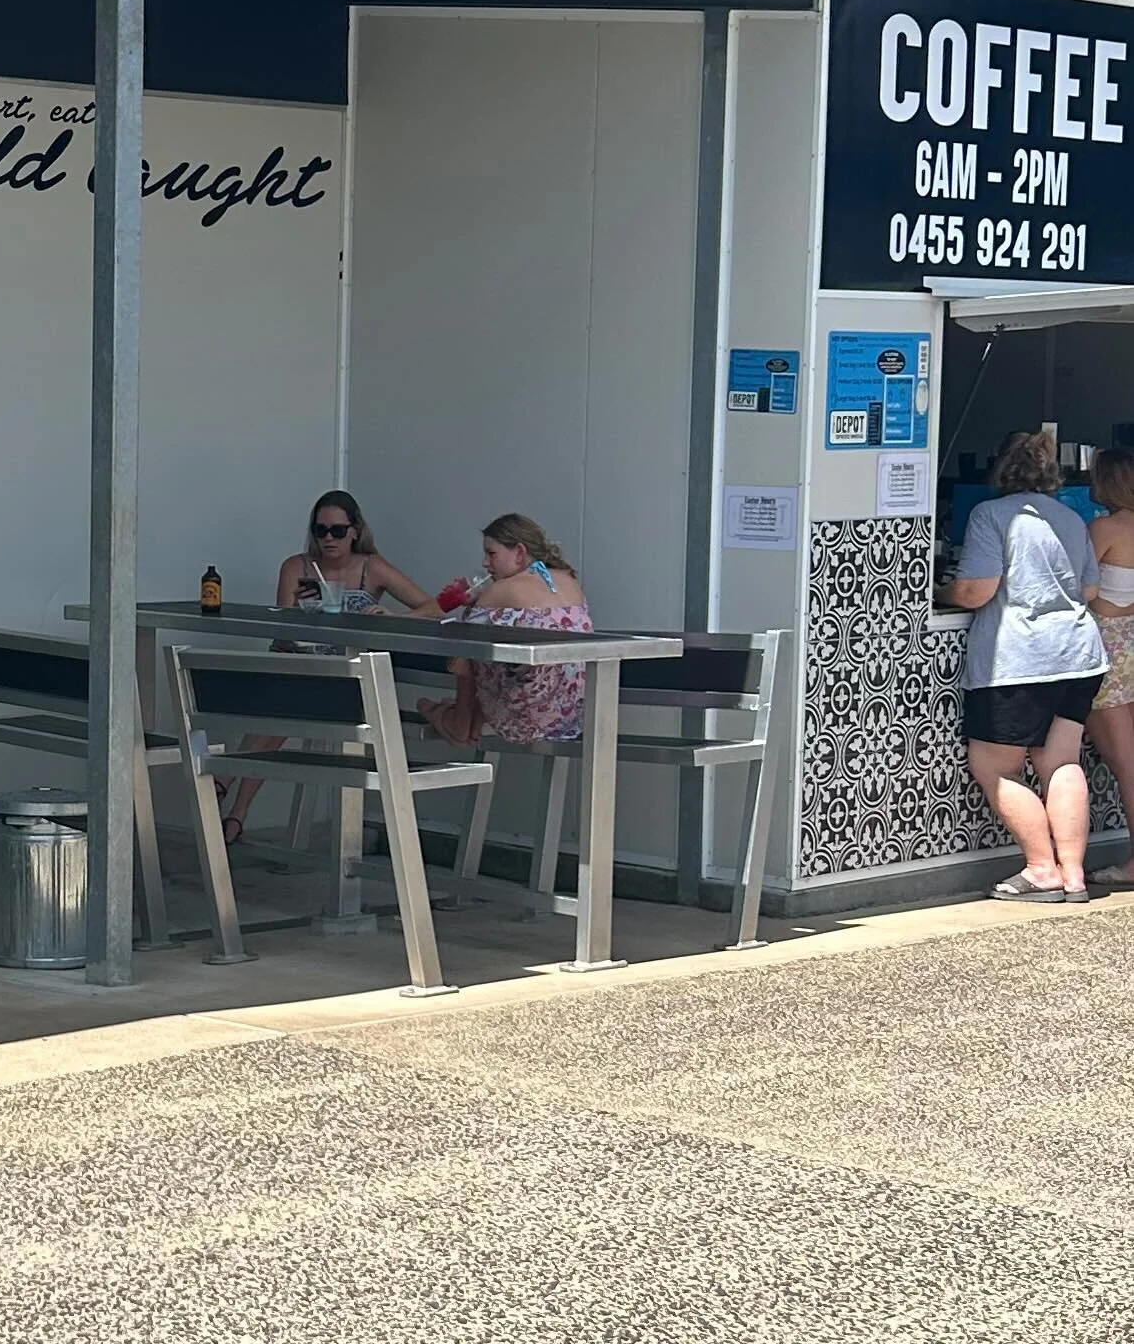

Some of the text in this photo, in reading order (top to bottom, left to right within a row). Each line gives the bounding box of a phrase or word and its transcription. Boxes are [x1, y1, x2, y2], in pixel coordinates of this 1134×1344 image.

[879, 13, 1127, 144] COFFEE
[49, 102, 96, 124] eat
[88, 146, 332, 227] ught
[915, 140, 1069, 207] 6AM - 2PM
[889, 213, 1087, 271] 0455 924 291
[835, 415, 865, 434] DEPOT
